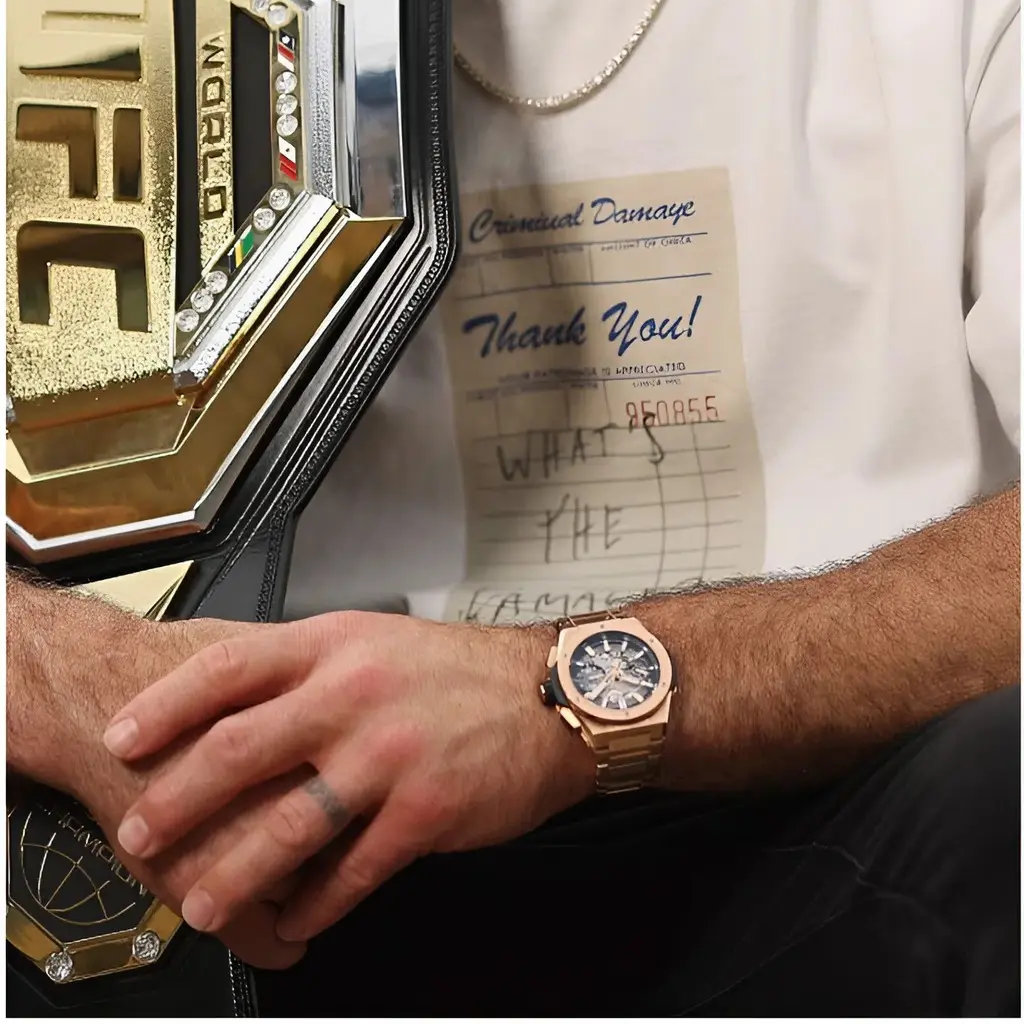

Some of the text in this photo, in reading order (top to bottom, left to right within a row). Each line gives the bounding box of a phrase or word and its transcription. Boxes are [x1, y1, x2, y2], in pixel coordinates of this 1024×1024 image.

[469, 202, 584, 243] Criminal
[462, 295, 702, 358] Thank You!
[538, 493, 623, 564] THE
